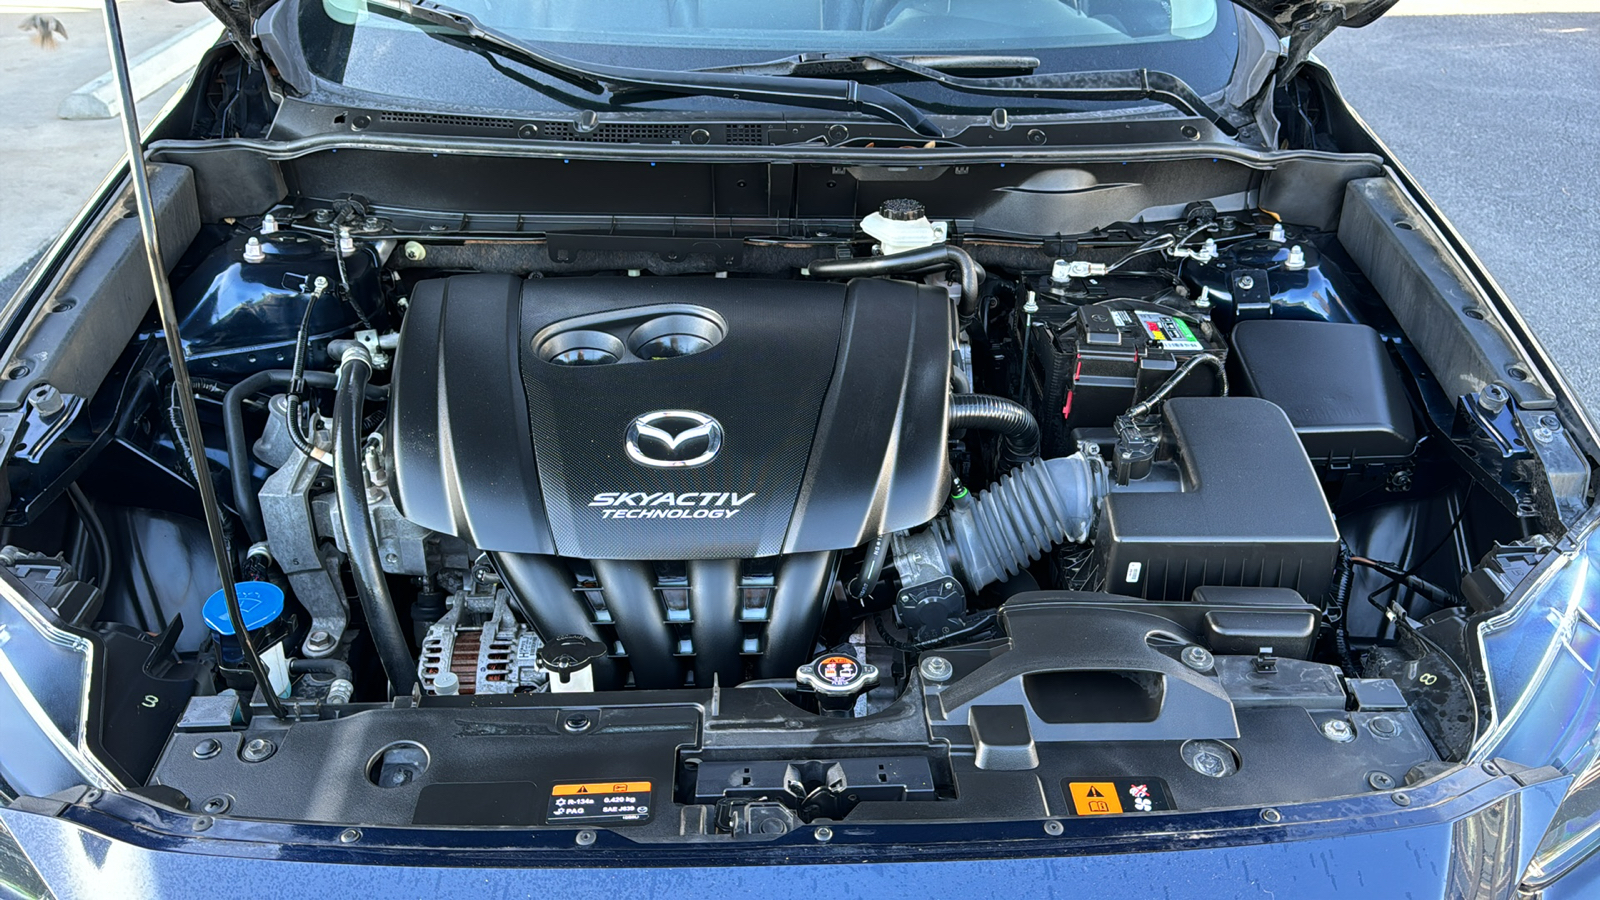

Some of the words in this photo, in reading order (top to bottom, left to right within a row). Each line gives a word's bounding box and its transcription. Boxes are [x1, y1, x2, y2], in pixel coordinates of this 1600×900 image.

[588, 492, 756, 507] SKYACTIV
[602, 509, 740, 520] TECHNOLOGY
[625, 796, 637, 804] kg
[565, 807, 585, 815] PAG
